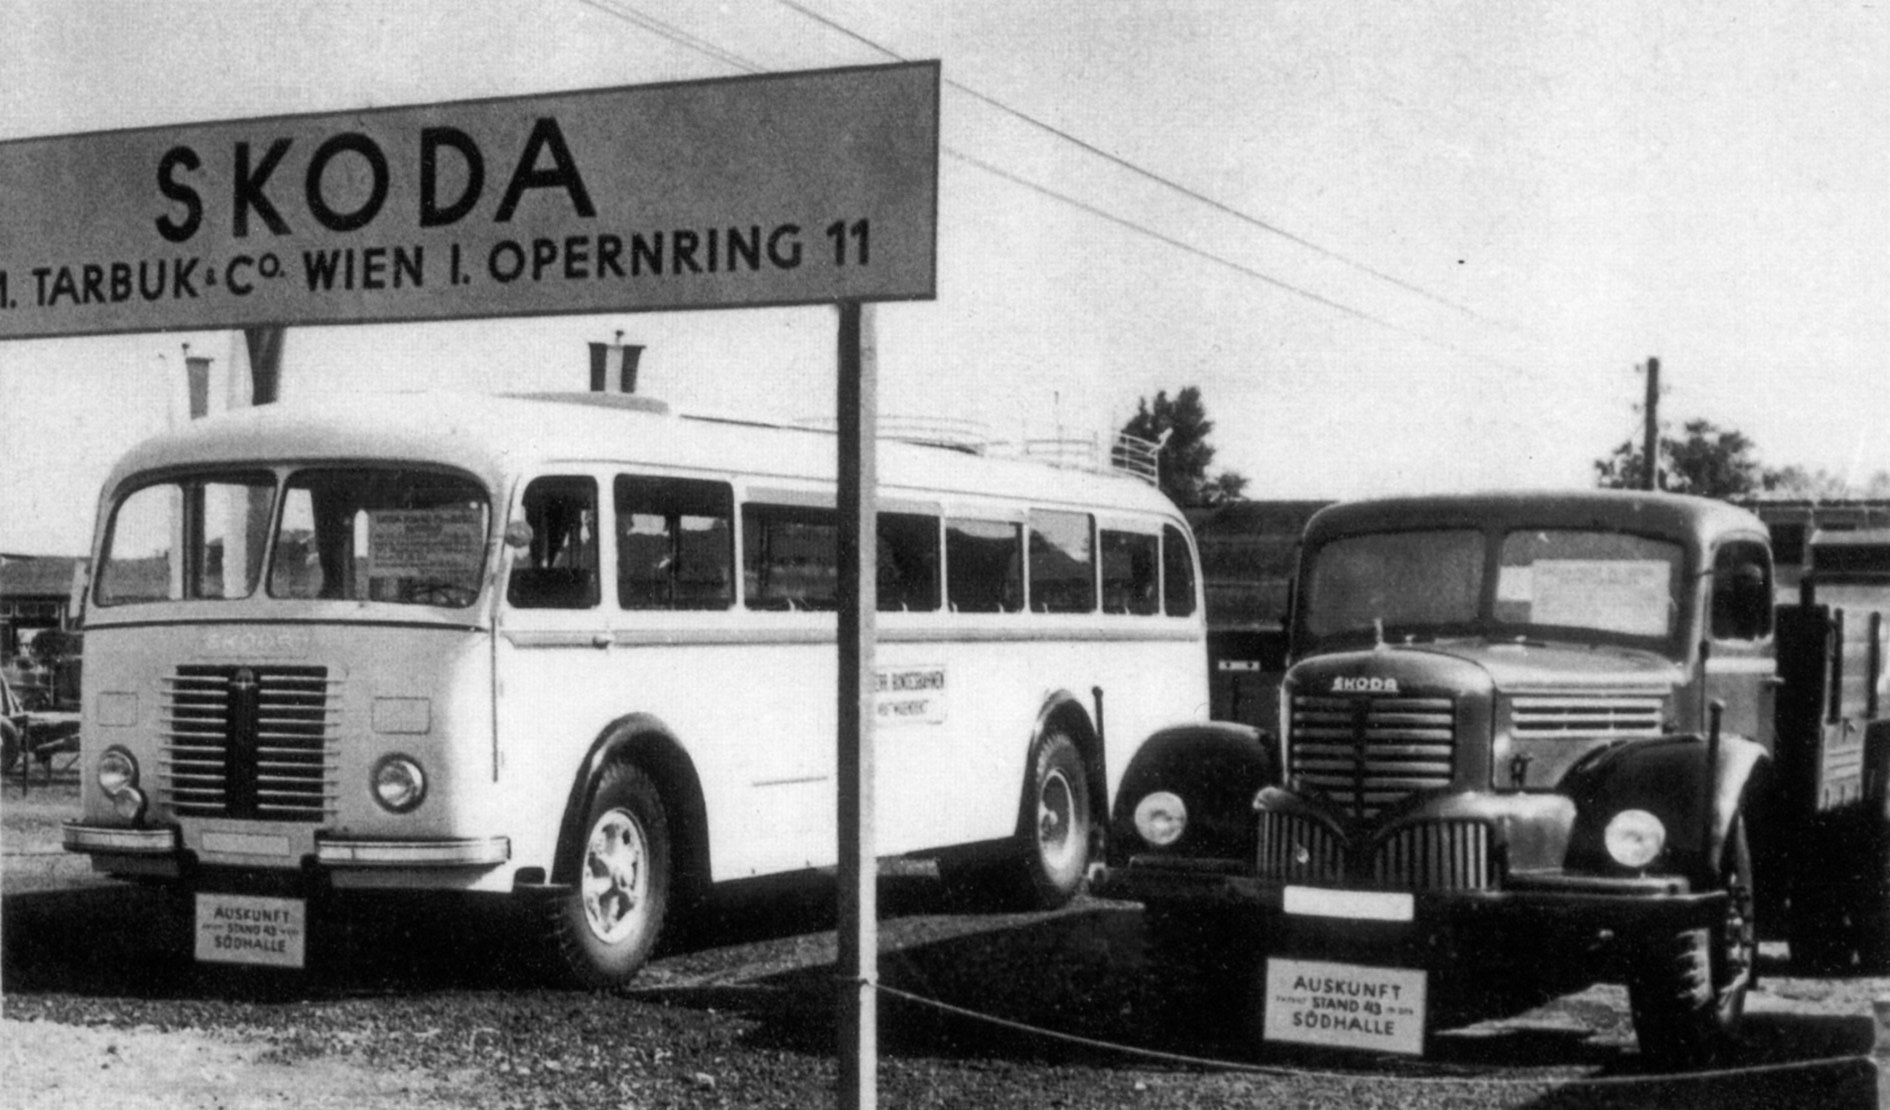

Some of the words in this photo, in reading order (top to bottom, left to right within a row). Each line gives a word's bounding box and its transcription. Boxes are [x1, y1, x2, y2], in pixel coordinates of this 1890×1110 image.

[154, 117, 597, 244] SKODA
[31, 257, 199, 306] TARBUK
[303, 245, 424, 291] WIEN
[488, 222, 802, 283] OPERNRING
[826, 218, 870, 266] 11
[214, 906, 289, 922] AUSKUNFT
[1293, 974, 1402, 1000] AUSKUNFT
[1312, 995, 1360, 1014] STAND
